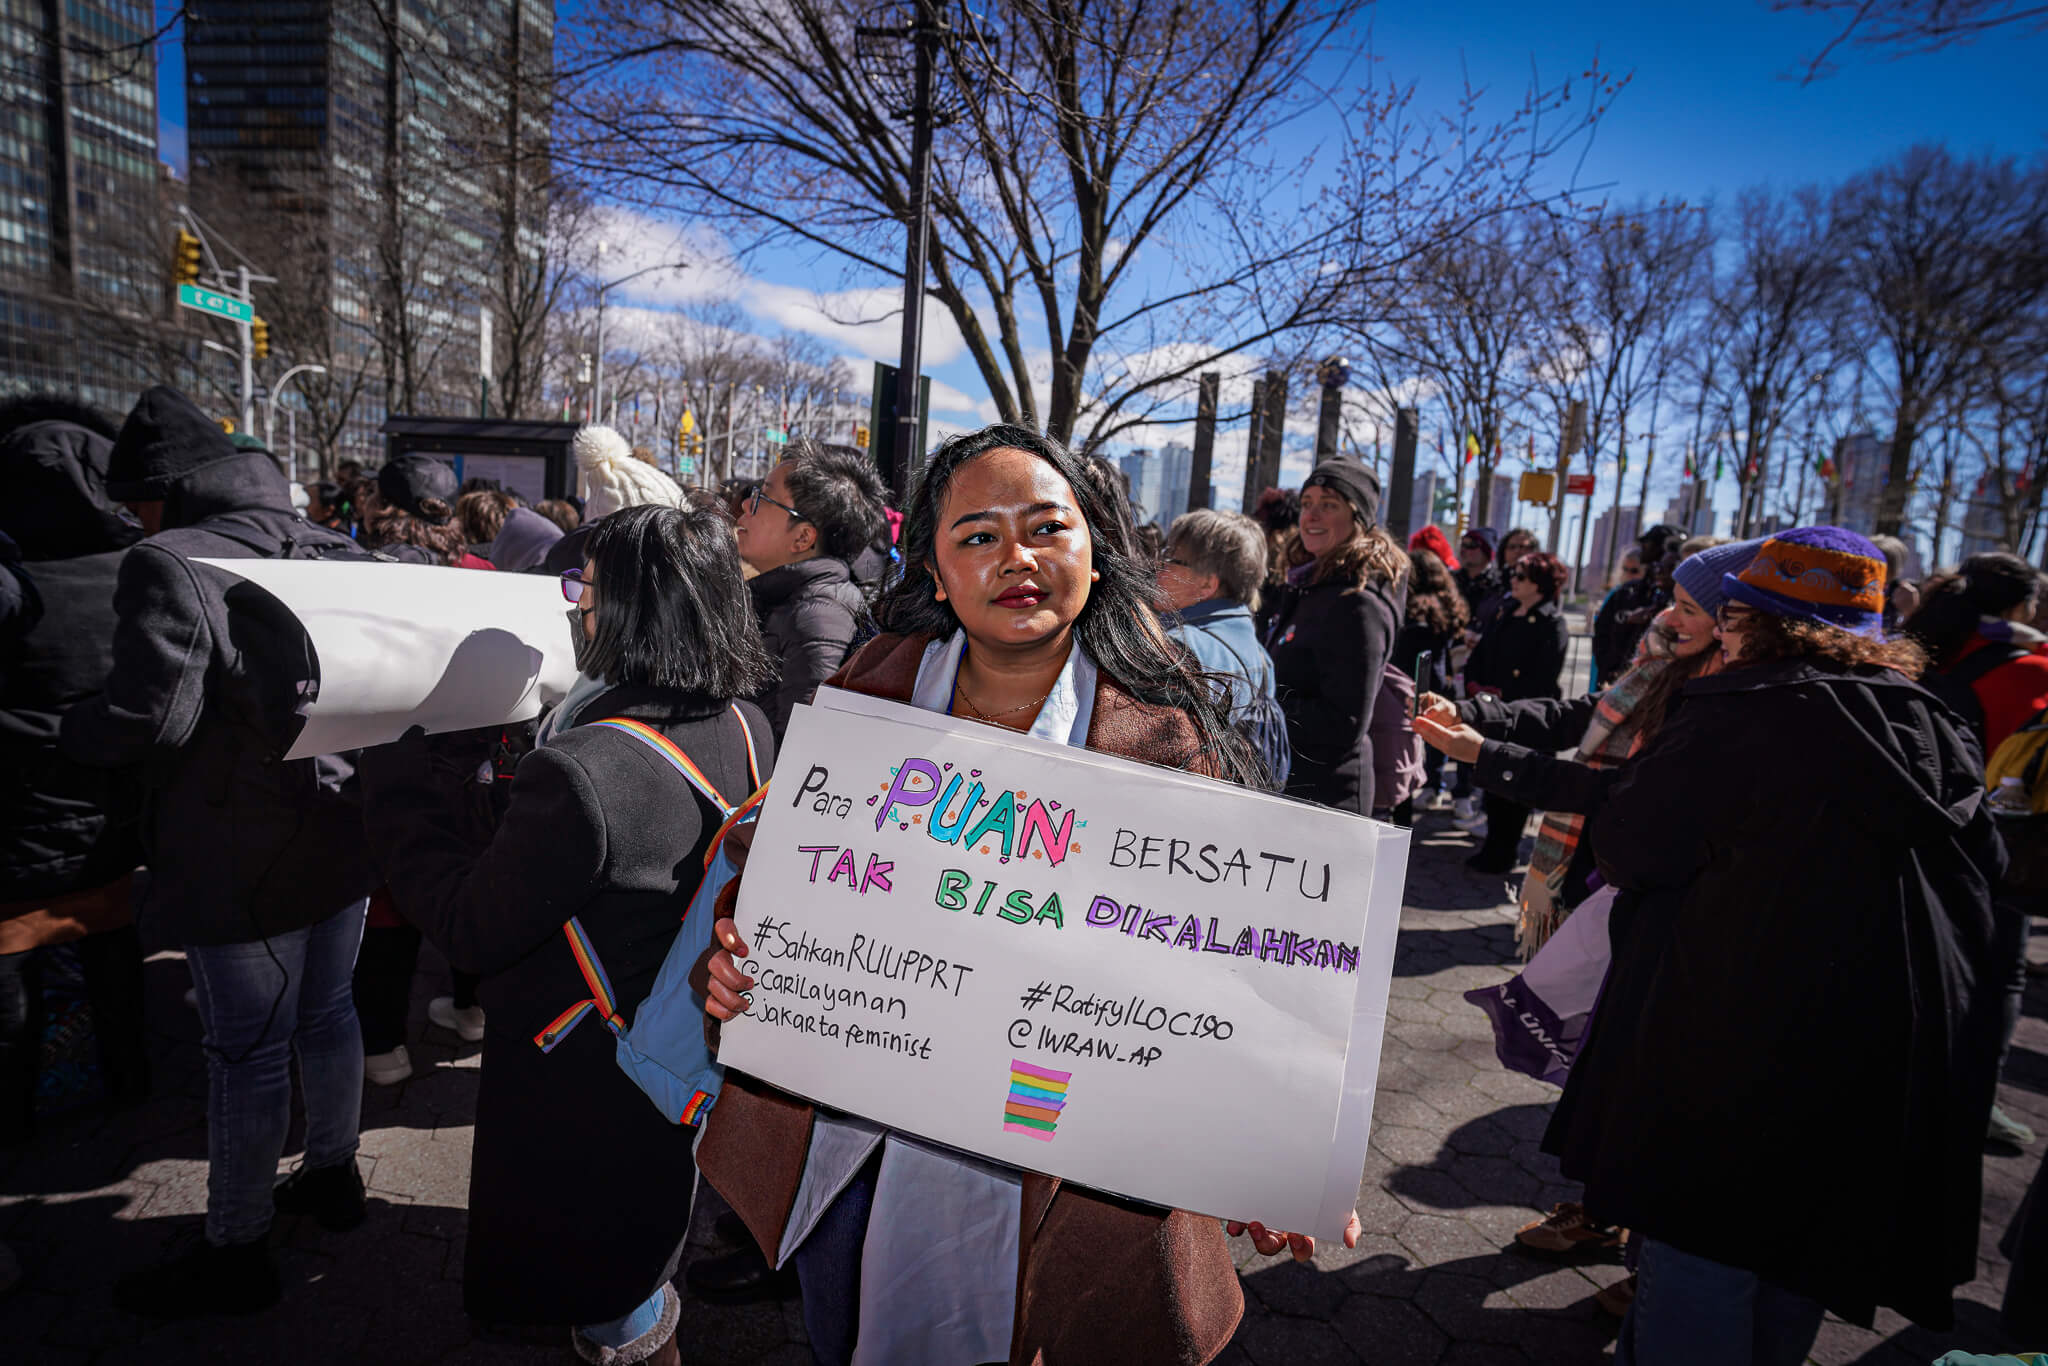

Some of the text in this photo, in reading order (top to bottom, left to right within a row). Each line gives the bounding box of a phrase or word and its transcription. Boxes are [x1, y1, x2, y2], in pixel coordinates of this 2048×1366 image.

[793, 757, 1331, 903] Para PUAN BERSATU
[798, 844, 1361, 976] TAK BISA DIKALAHKAN
[1008, 1018, 1163, 1067] @IWRAW_AP
